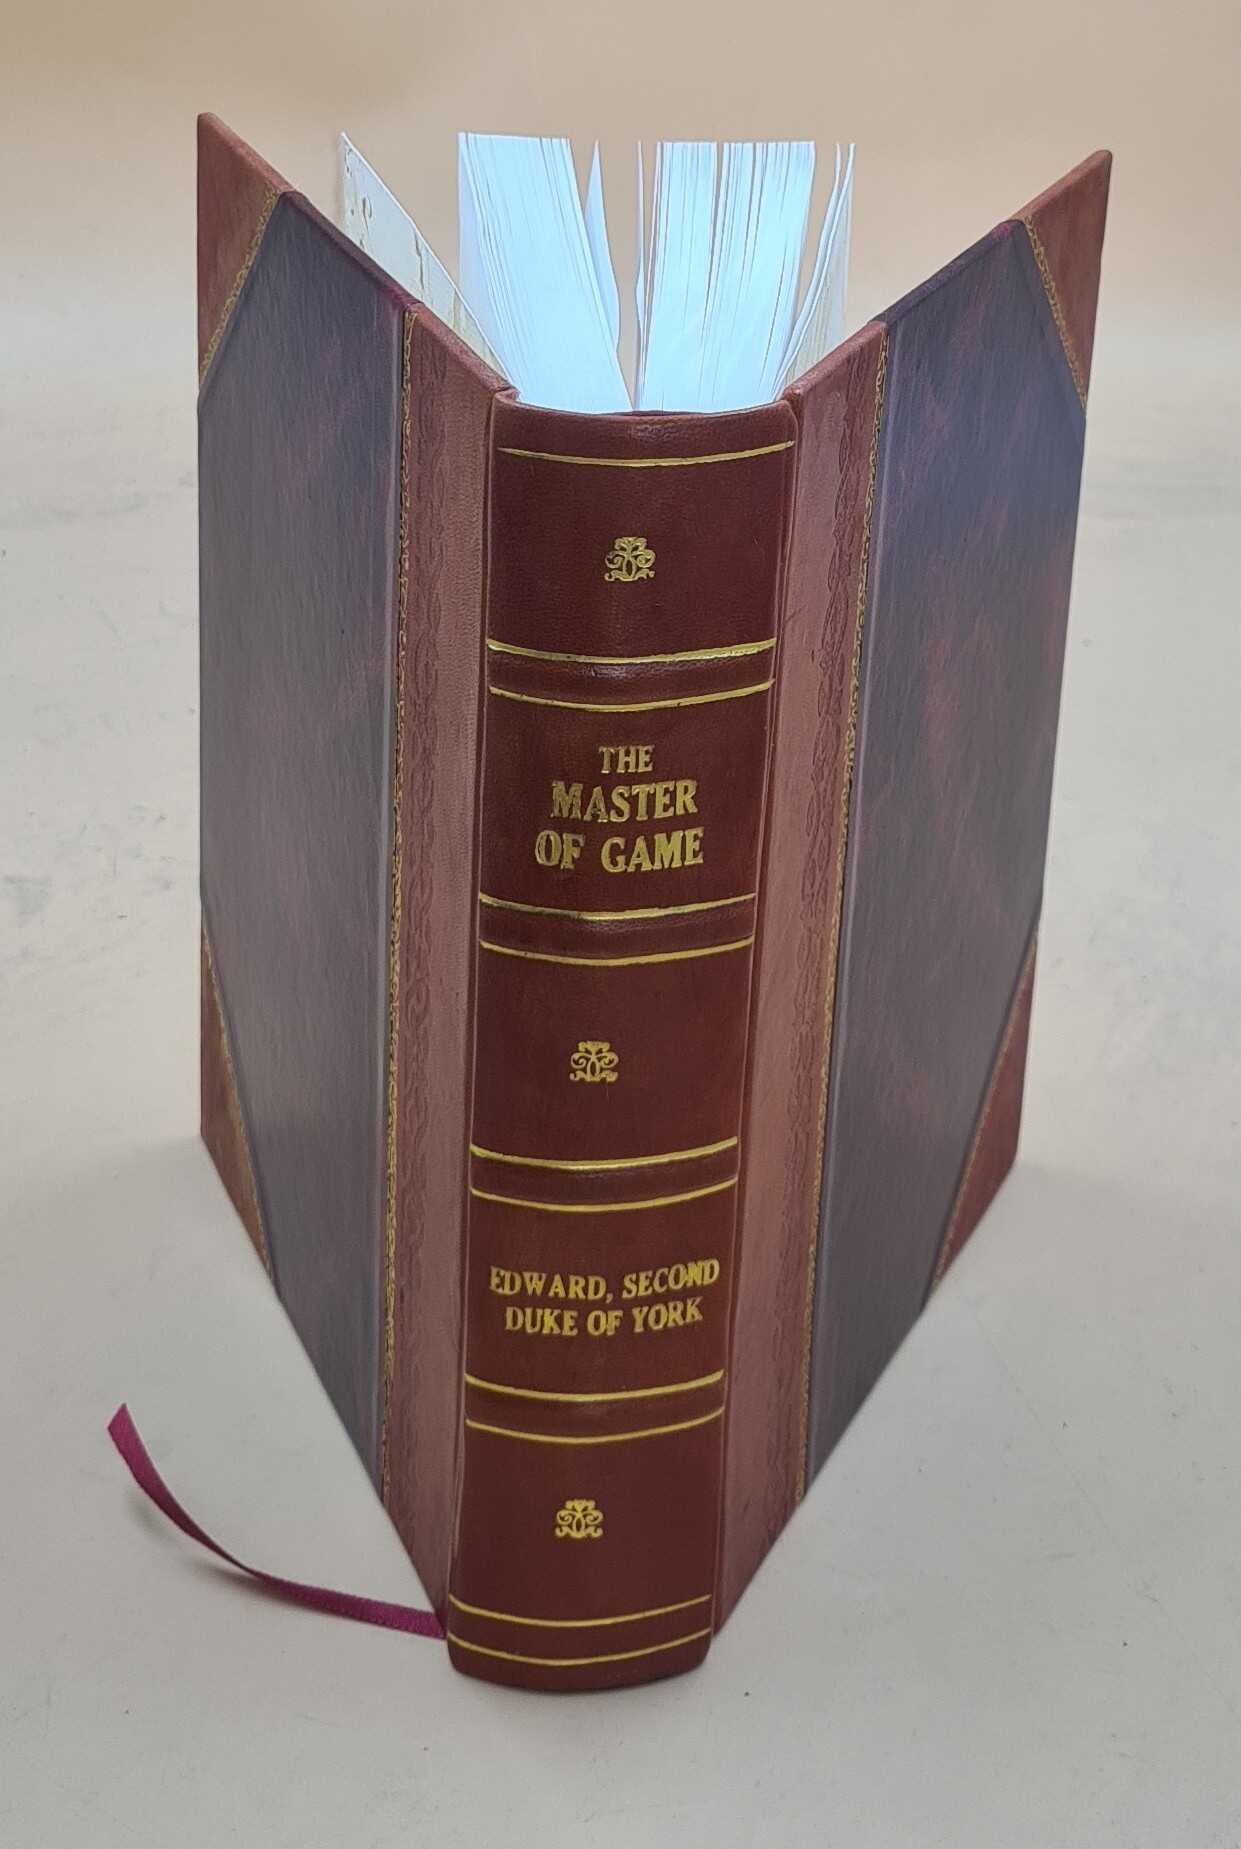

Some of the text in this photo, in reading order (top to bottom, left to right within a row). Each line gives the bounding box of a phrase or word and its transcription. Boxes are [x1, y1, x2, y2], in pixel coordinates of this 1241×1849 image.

[599, 745, 654, 774] THE
[551, 779, 698, 823] MASTER
[534, 827, 704, 873] OF GAME
[490, 1258, 721, 1304] EDWARD, SECOND
[504, 1297, 704, 1336] DUKE OF YORK
